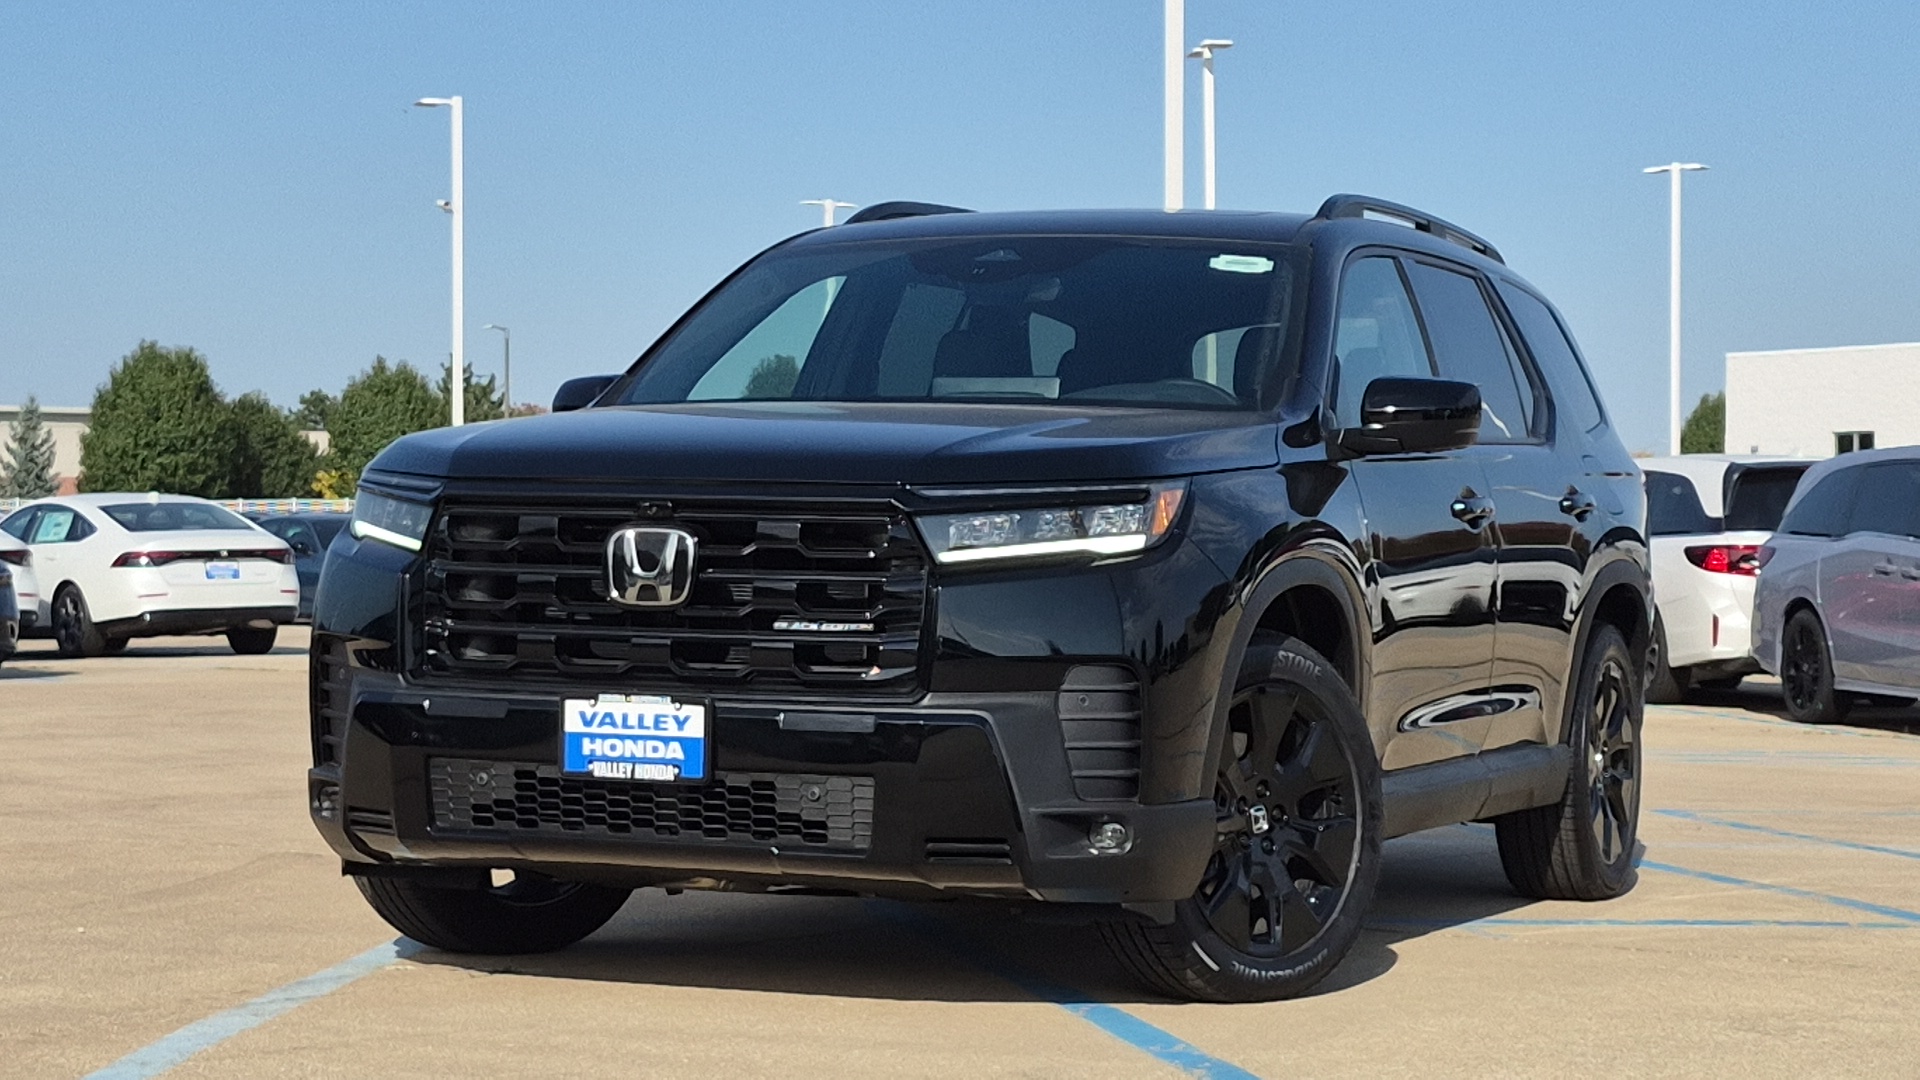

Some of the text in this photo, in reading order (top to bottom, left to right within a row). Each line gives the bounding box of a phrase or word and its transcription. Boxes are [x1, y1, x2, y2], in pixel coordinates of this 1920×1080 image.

[578, 710, 692, 732] VALLEY
[582, 737, 685, 760] HONDA
[592, 761, 633, 779] VALLEY
[634, 763, 675, 781] HONDA
